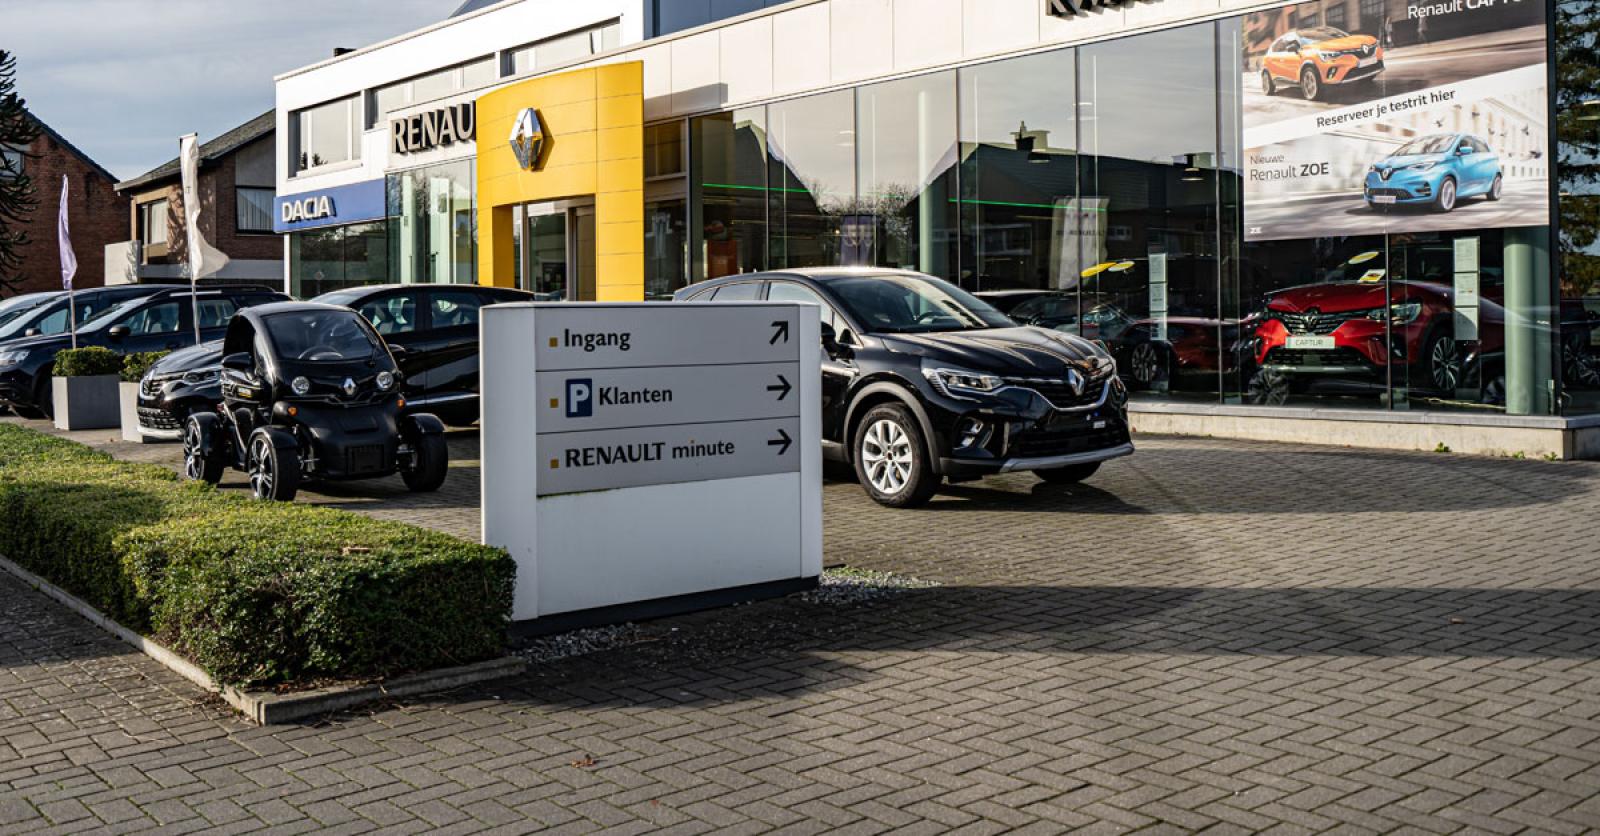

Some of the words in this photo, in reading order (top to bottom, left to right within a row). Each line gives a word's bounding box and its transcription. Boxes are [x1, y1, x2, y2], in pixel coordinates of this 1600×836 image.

[1407, 0, 1463, 19] Renault
[1316, 107, 1374, 128] Reserveer
[1376, 104, 1388, 118] je
[1389, 95, 1427, 112] testrit
[1430, 90, 1456, 103] hier
[1250, 155, 1285, 165] Nieuwe
[1250, 165, 1297, 181] Renault
[1300, 162, 1329, 177] ZOE
[282, 195, 334, 222] DACIA
[564, 328, 631, 352] Ingang
[569, 383, 589, 413] P
[599, 386, 673, 406] Klanten
[565, 442, 666, 468] RENAULT
[672, 439, 735, 459] minute
